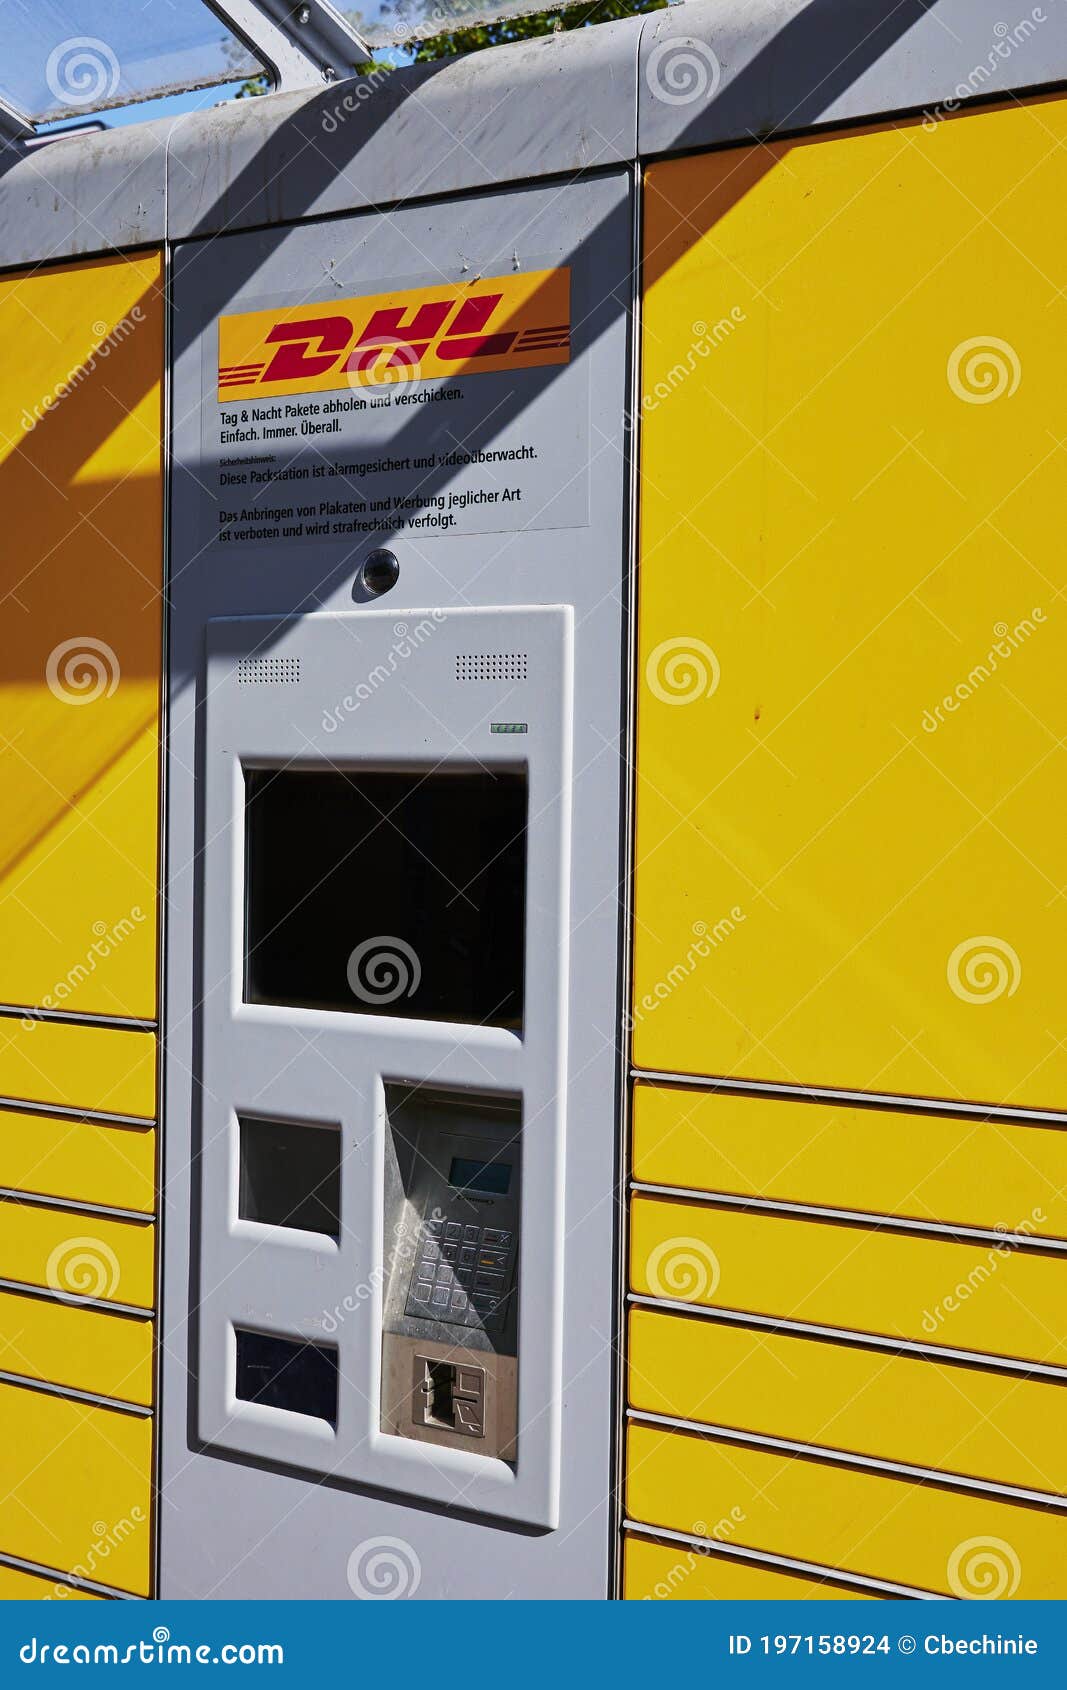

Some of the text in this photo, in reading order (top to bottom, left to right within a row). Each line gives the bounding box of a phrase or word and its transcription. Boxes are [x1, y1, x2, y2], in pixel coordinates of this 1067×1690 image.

[259, 293, 518, 382] DHL
[220, 386, 465, 427] Tag & Nacht Pakete abholen und verschicken.
[220, 418, 342, 444] Einfach. Immer. Überall.
[219, 445, 538, 486] Diese Packstation ist alarmgesichert und videoüberwacht.
[219, 488, 522, 523] Das Anbringen von Plakaten und Werbung jeglicher Art
[219, 513, 457, 542] ist verboten und wird strafrechtlich verfolgt.
